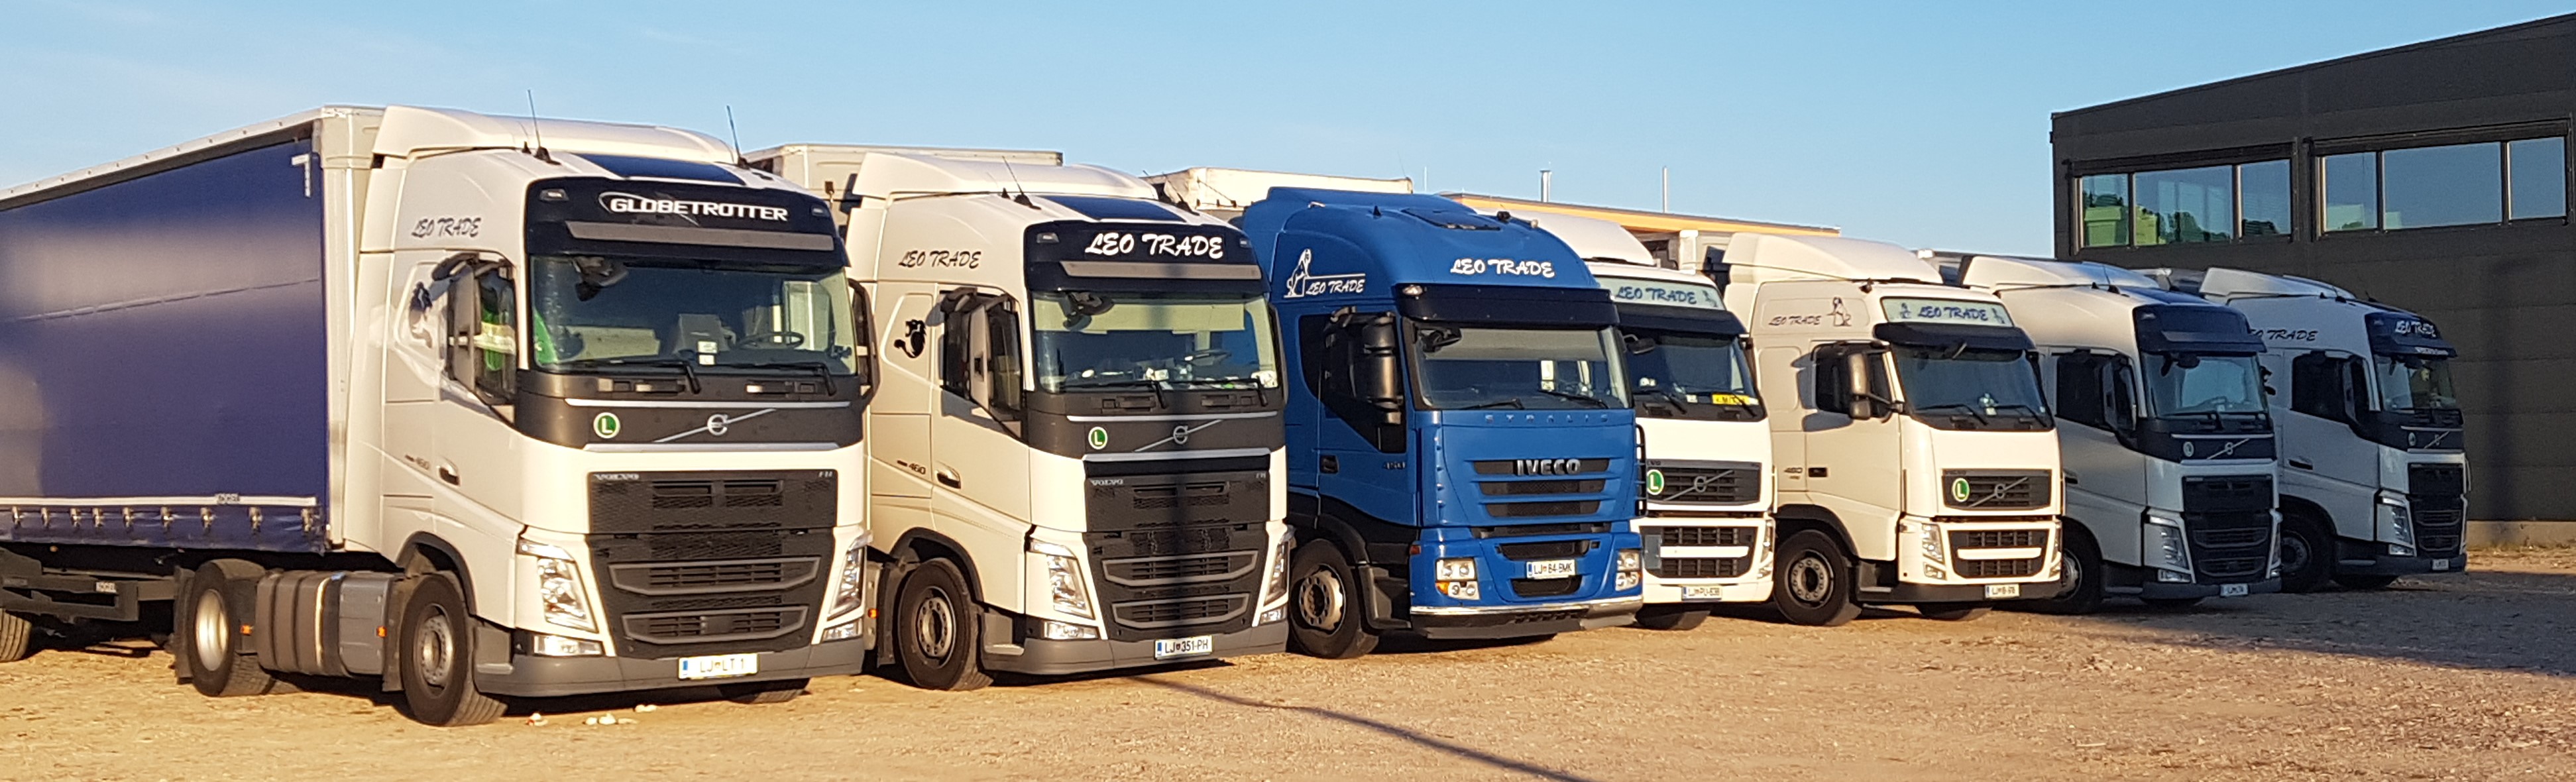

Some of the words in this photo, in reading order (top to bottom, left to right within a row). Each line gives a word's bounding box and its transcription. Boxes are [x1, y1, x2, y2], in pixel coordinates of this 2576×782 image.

[610, 197, 788, 221] GLOBETROTTER
[411, 218, 435, 238] LEO
[437, 217, 481, 237] TRADE
[1084, 232, 1135, 256] LEO
[1141, 233, 1223, 259] TRADE
[898, 250, 926, 268] LEO
[929, 250, 981, 268] TRADE
[1450, 258, 1486, 275] LEO
[1487, 258, 1555, 278] TRADE
[1305, 281, 1326, 296] LEO
[1327, 278, 1365, 294] TRADE
[1616, 286, 1643, 300] LEO
[1646, 287, 1697, 305] TRADE
[1768, 315, 1787, 327] LEO
[1918, 306, 1942, 318] LEO
[1944, 306, 1988, 321] TRADE
[2267, 329, 2319, 341] TRADE
[601, 418, 613, 433] L
[1484, 414, 1609, 423] STRALIS
[1517, 458, 1581, 476] IVECO
